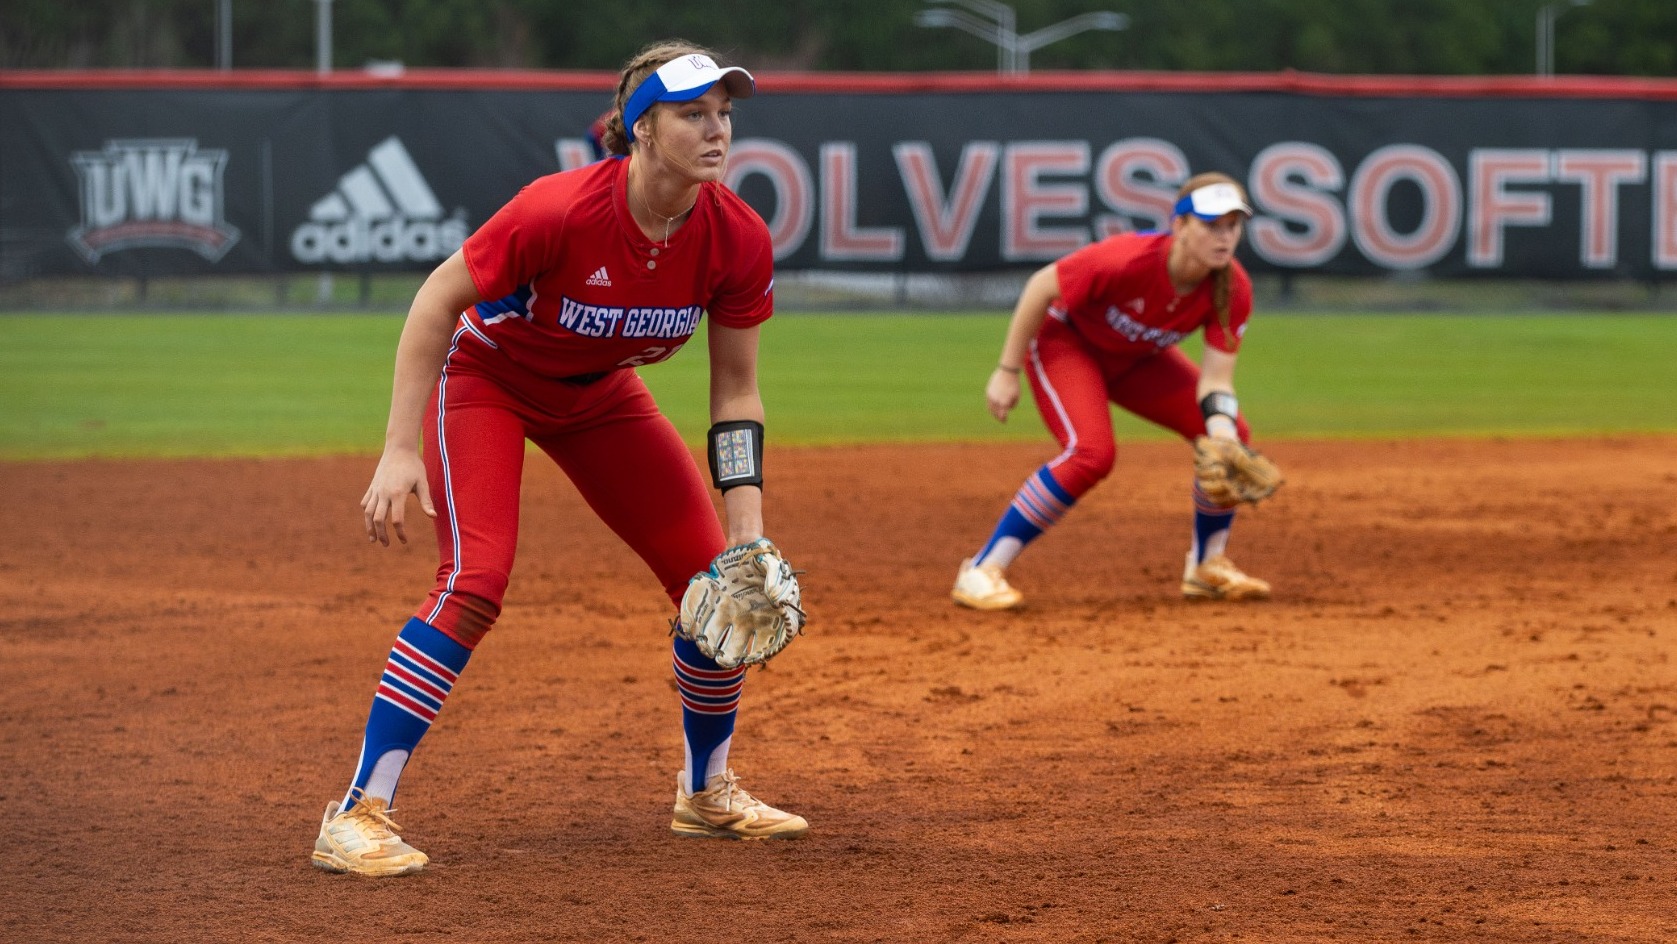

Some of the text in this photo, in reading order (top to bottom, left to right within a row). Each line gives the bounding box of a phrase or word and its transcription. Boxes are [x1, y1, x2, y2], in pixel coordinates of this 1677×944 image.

[76, 140, 224, 227] UWG
[1248, 140, 1677, 269] SOFT
[290, 213, 469, 263] adidas
[586, 278, 612, 287] adidas
[559, 296, 701, 338] WEST GEORGIA
